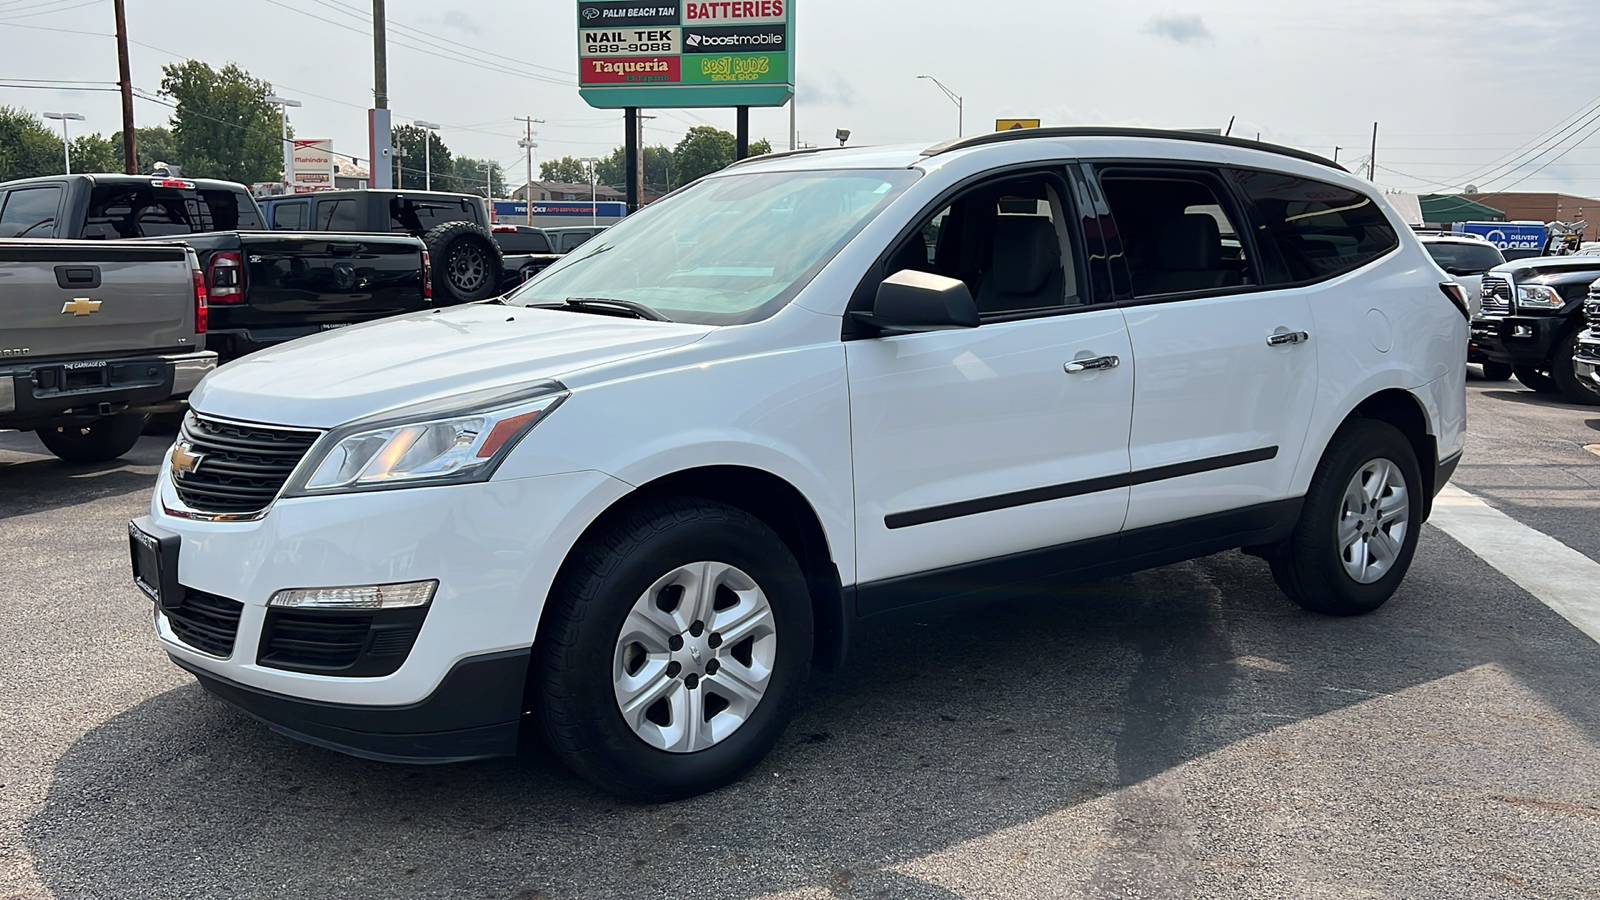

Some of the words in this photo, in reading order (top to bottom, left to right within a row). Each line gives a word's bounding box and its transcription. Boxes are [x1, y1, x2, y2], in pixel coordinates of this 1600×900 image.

[603, 9, 626, 18] PALM
[627, 8, 656, 17] BEACH
[658, 7, 675, 16] TAN
[686, 0, 783, 19] BATTERIES
[586, 32, 627, 43] NAIL
[634, 30, 672, 42] TEK
[702, 33, 783, 46] boostmobile
[588, 43, 671, 53] 689-9088
[733, 56, 769, 74] BUDZ
